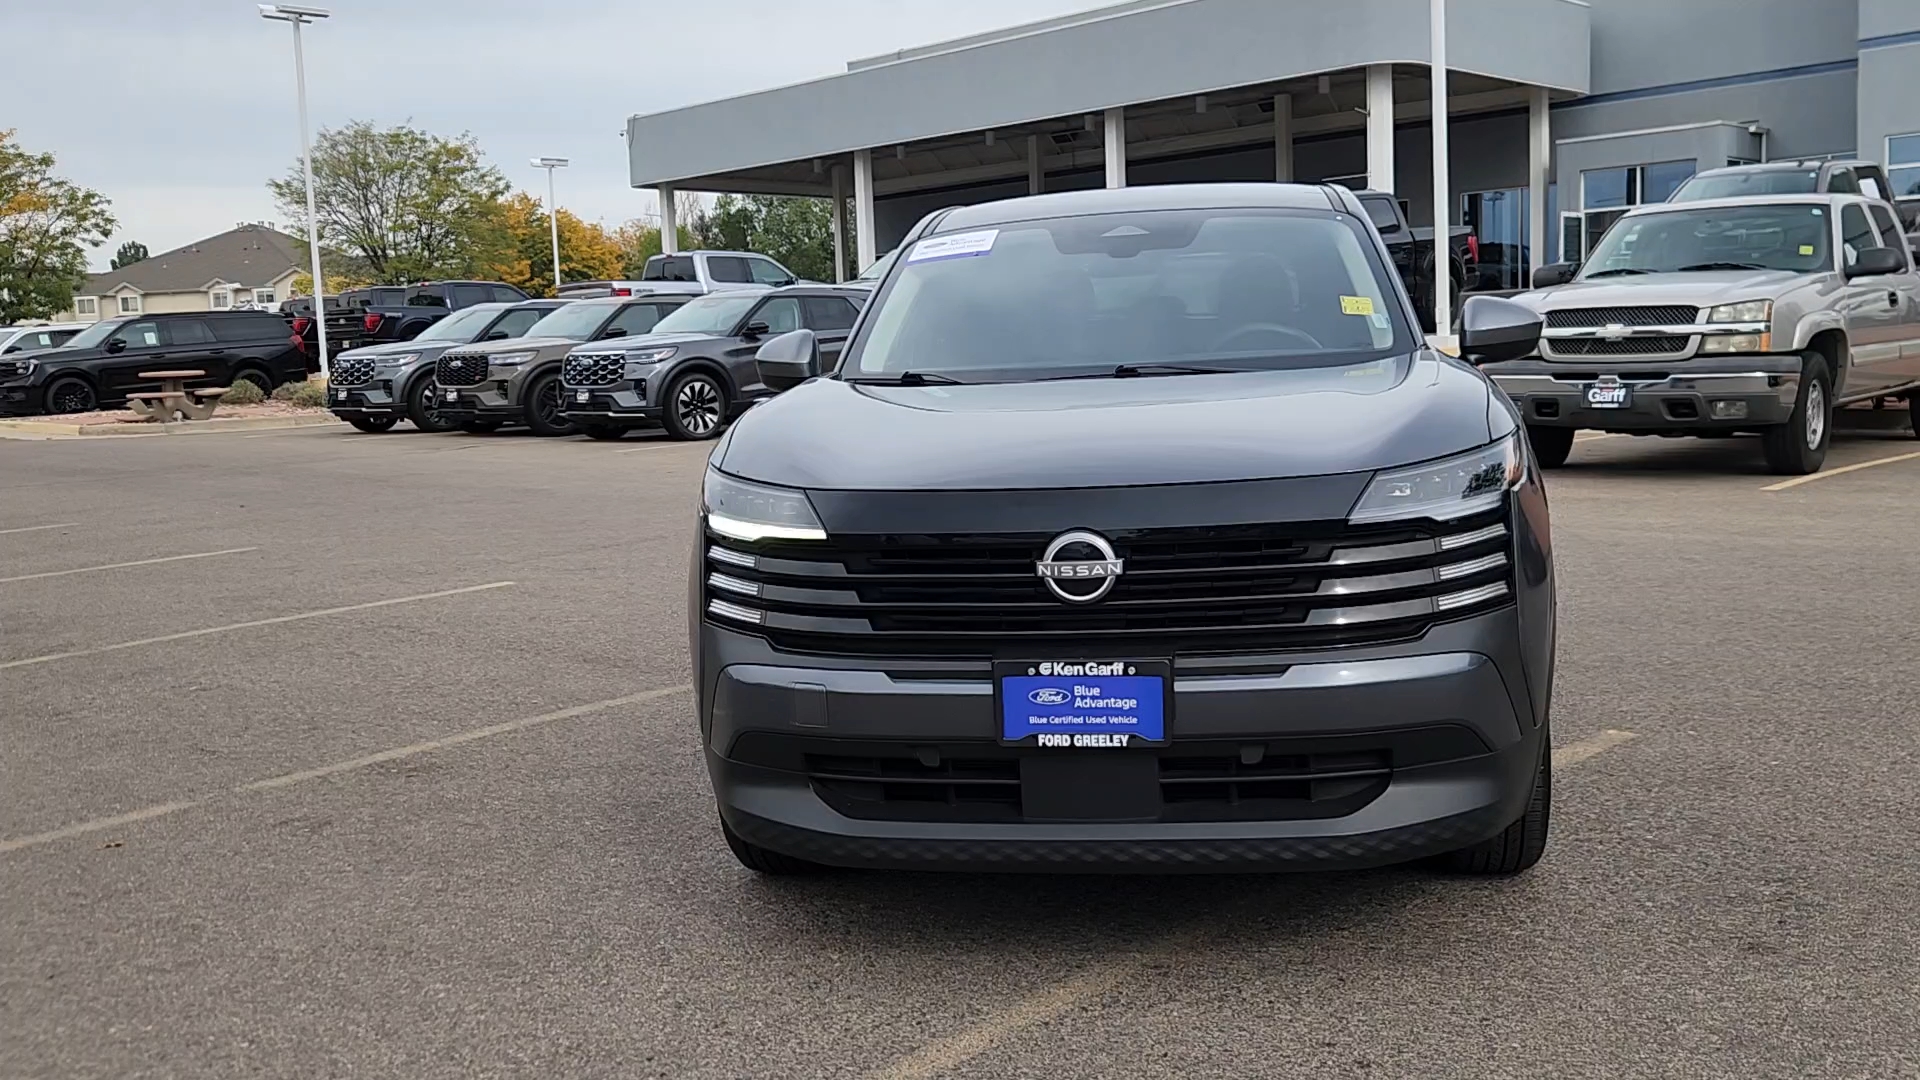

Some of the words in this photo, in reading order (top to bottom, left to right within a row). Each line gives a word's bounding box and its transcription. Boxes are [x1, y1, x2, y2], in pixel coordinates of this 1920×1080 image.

[1588, 388, 1626, 402] Garff
[1038, 563, 1121, 576] NISSAN
[1053, 662, 1084, 675] Ken
[1085, 662, 1124, 675] Garff
[1036, 691, 1063, 702] Ford
[1074, 685, 1100, 696] Blue
[1074, 698, 1137, 710] Advantage
[1029, 716, 1047, 724] Blue
[1049, 716, 1083, 724] Certified
[1085, 716, 1106, 724] Used
[1108, 716, 1138, 724] Vehicle
[1038, 734, 1071, 747] FORD
[1073, 734, 1129, 747] GREELEY
